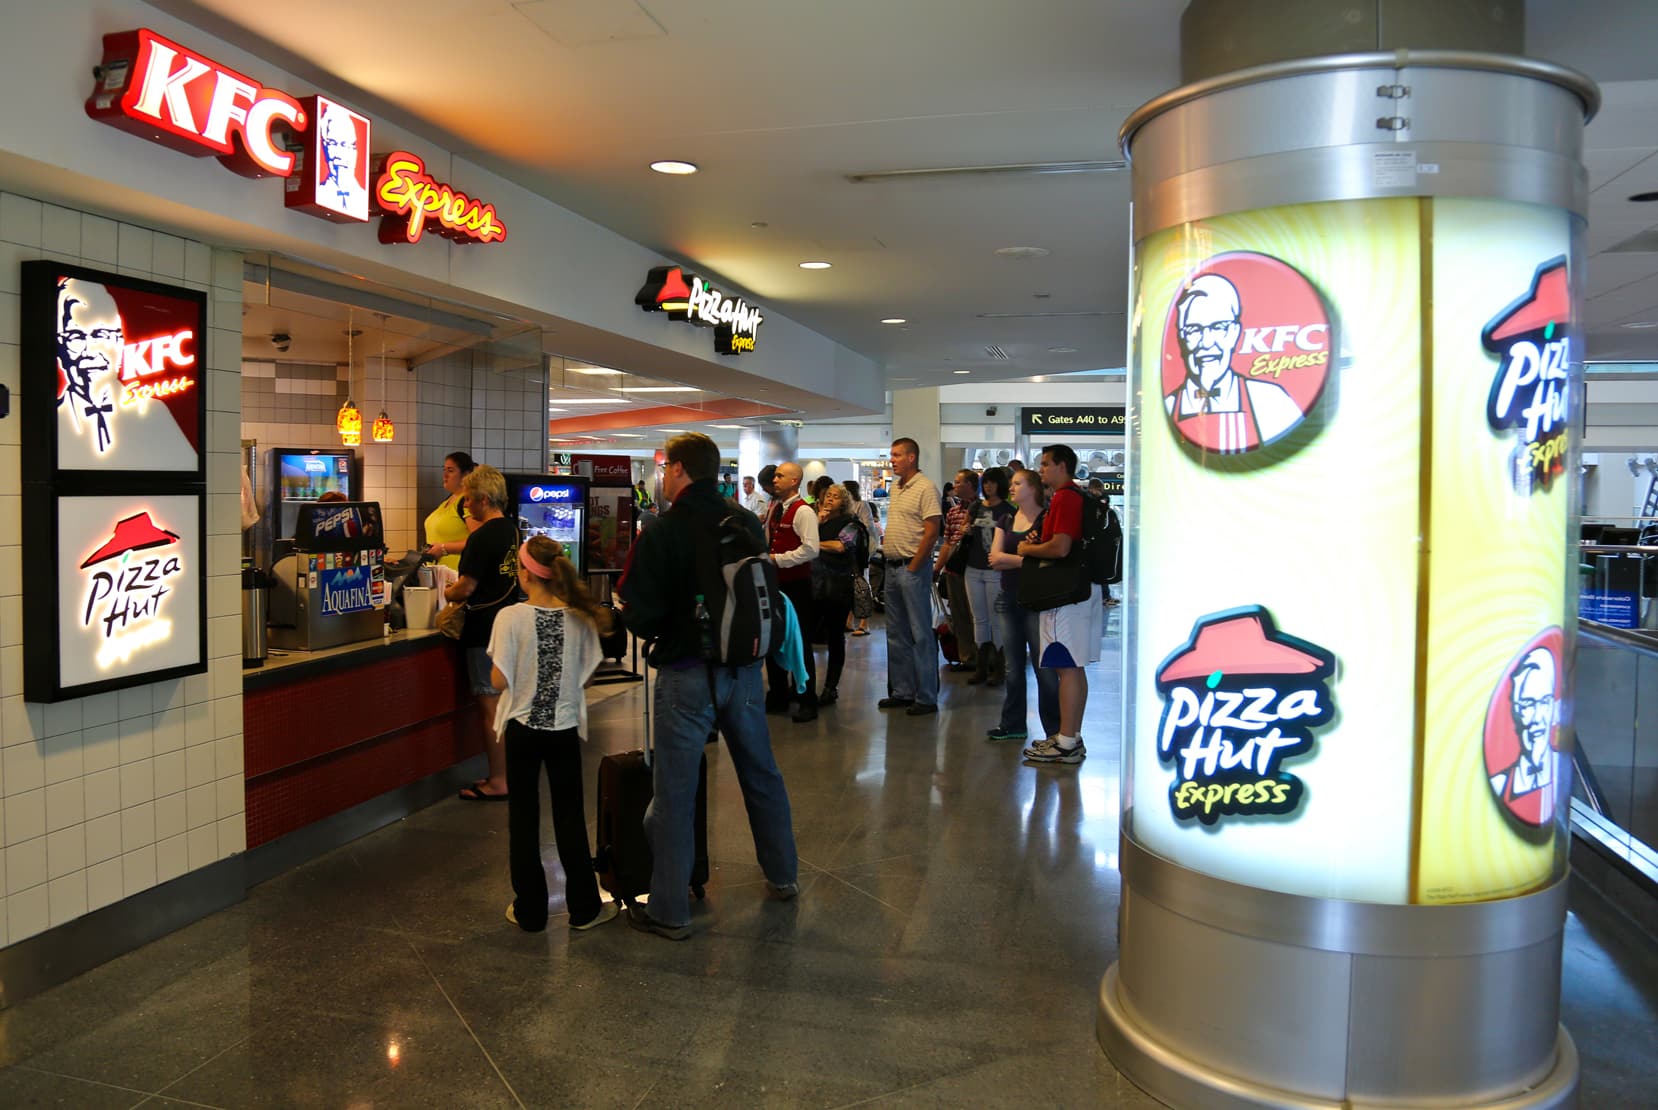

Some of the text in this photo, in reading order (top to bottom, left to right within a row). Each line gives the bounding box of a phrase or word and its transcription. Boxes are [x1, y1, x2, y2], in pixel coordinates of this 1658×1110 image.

[133, 40, 300, 171] KFC
[381, 162, 500, 236] Express
[687, 277, 762, 341] Pizza Hut
[122, 331, 194, 380] KFC
[1238, 324, 1329, 355] KFC
[1250, 350, 1328, 381] Express
[122, 376, 194, 415] Express
[1048, 415, 1126, 425] Gates A40 to A9
[1522, 381, 1569, 443] Hu
[543, 488, 570, 500] pepsi
[315, 507, 353, 537] PEPSI
[85, 552, 180, 625] Pizza
[104, 585, 170, 638] Hut
[322, 577, 373, 615] AQUAFINA
[1162, 670, 1322, 750] Pizza
[1180, 726, 1301, 779] Hut
[1175, 780, 1292, 815] Express
